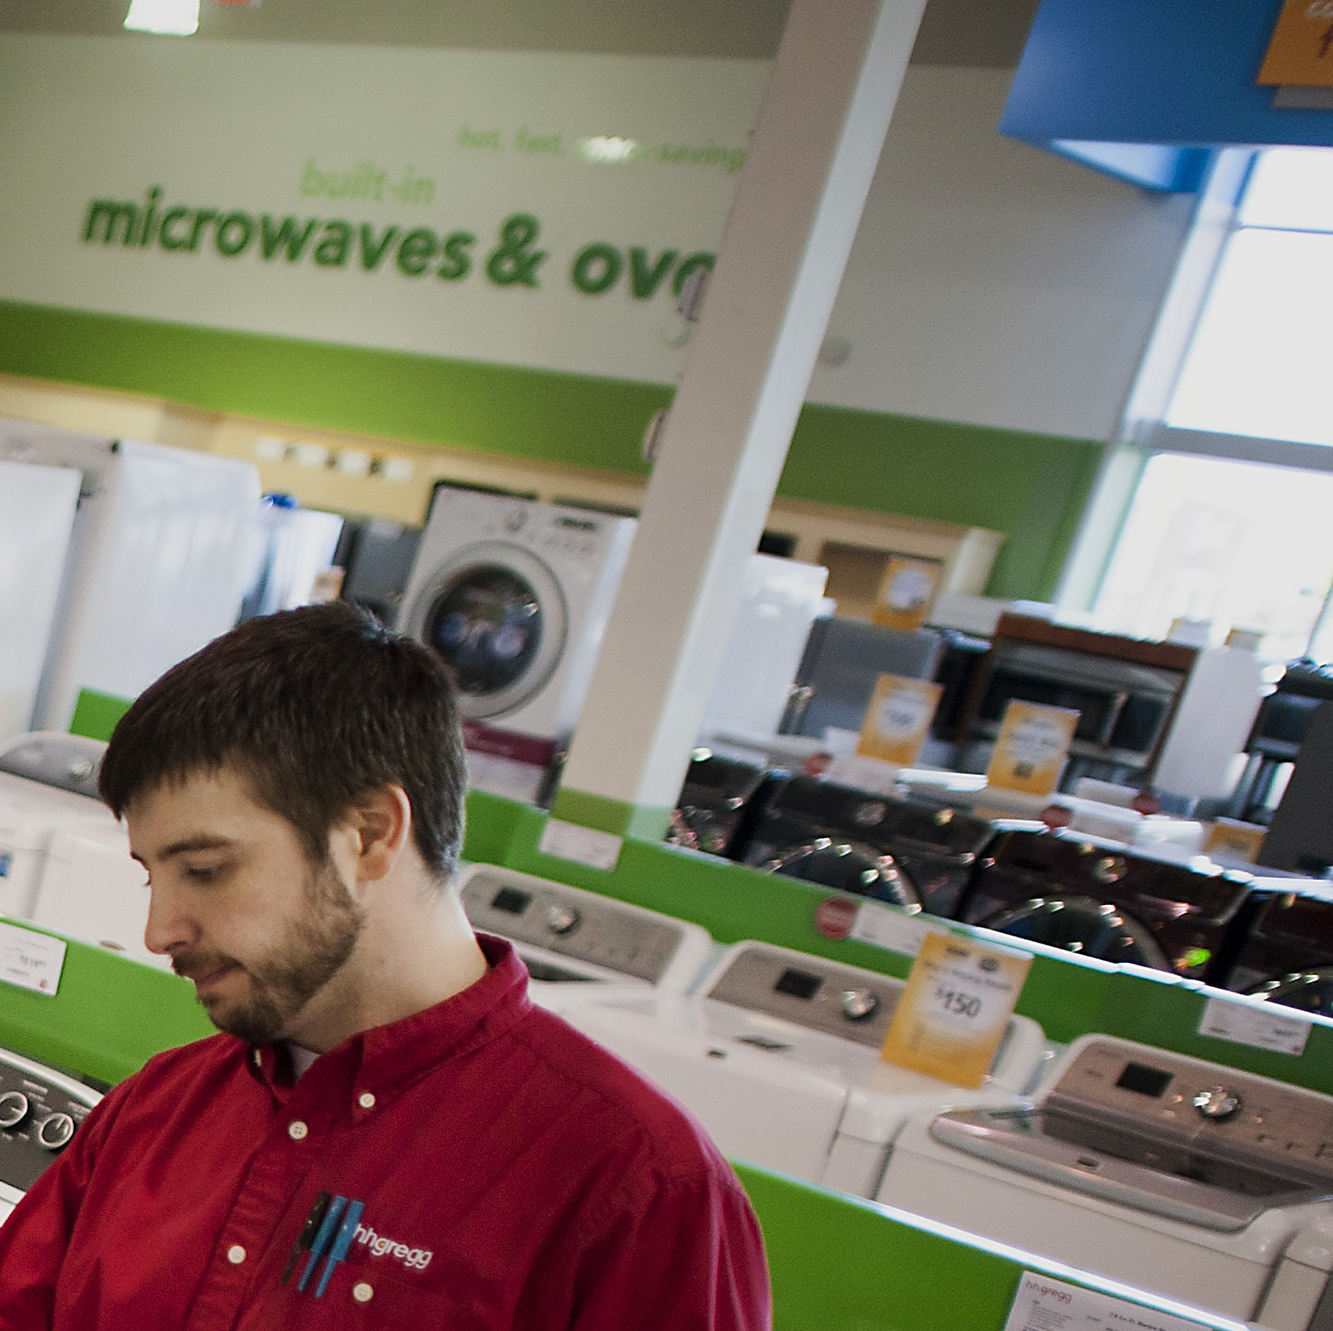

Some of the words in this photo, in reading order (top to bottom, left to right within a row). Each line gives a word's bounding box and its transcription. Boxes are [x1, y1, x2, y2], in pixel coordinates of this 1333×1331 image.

[300, 158, 436, 207] built-in
[81, 186, 475, 283] microwaves
[485, 213, 550, 290] &
[353, 1224, 433, 1269] hhgregg
